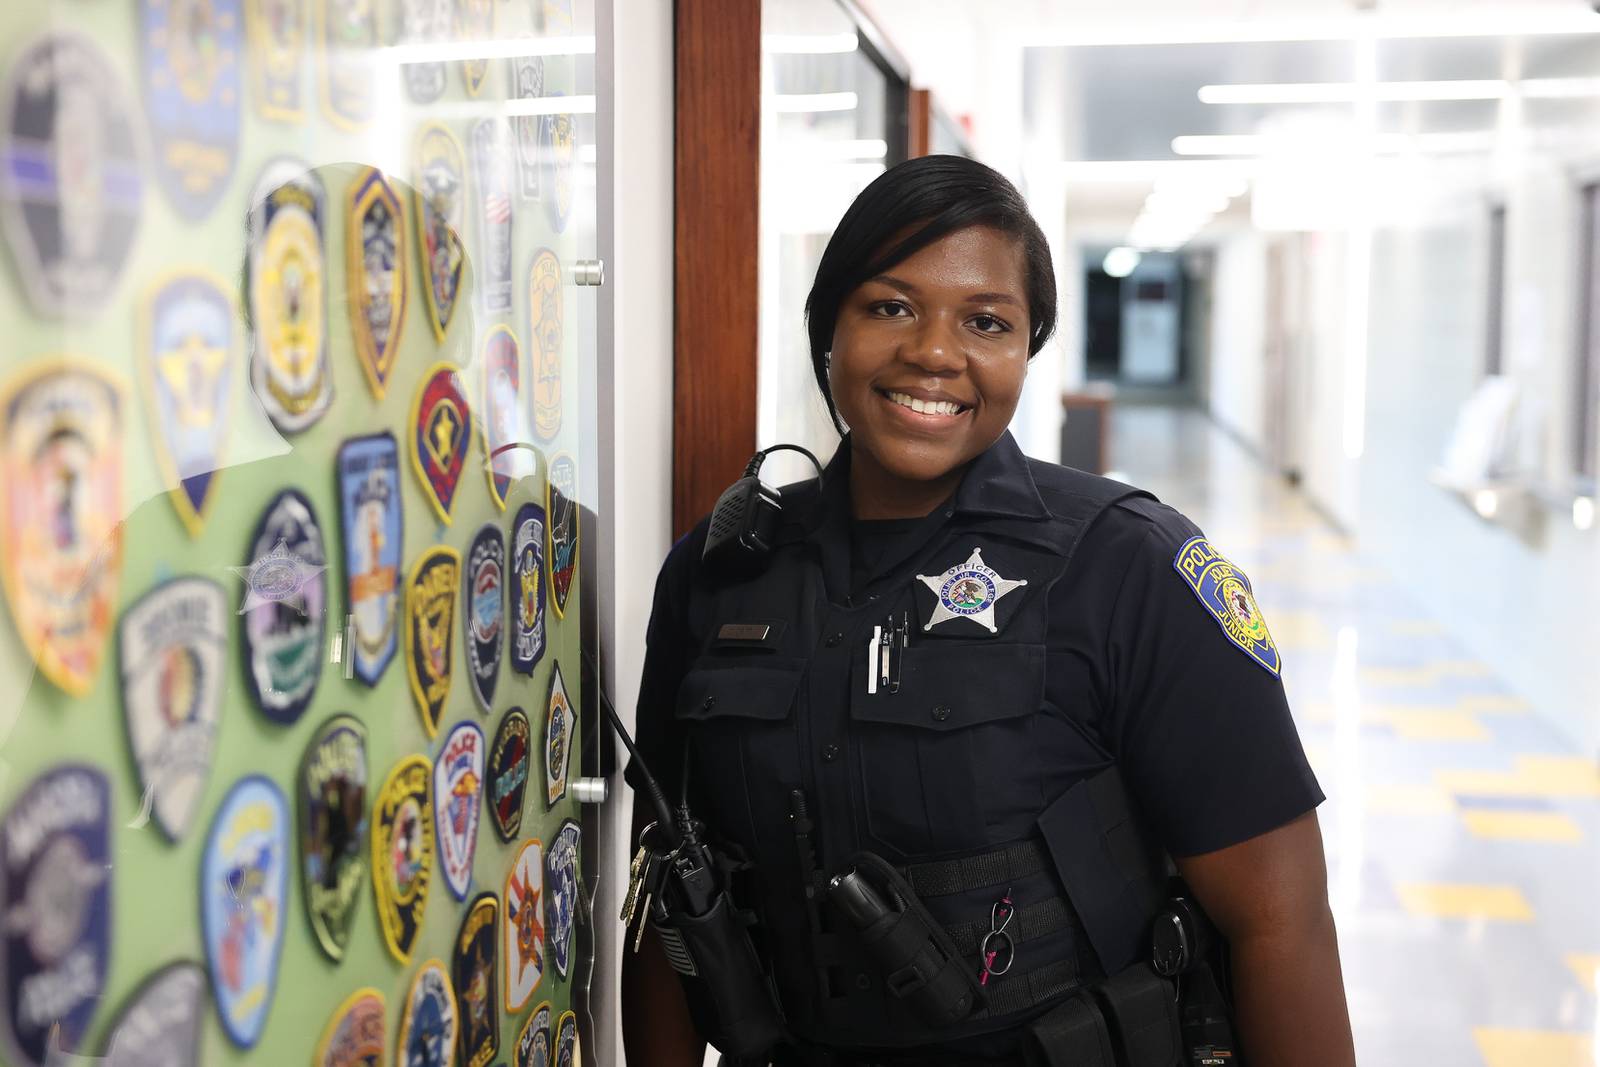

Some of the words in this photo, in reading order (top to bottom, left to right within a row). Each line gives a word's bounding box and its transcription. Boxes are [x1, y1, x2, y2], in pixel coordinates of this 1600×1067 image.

[948, 562, 997, 579] OFFICER
[941, 577, 957, 601] JOLIET
[974, 573, 995, 603] COLLEGE
[947, 603, 984, 615] POLICE
[1218, 610, 1254, 651] JUNIOR
